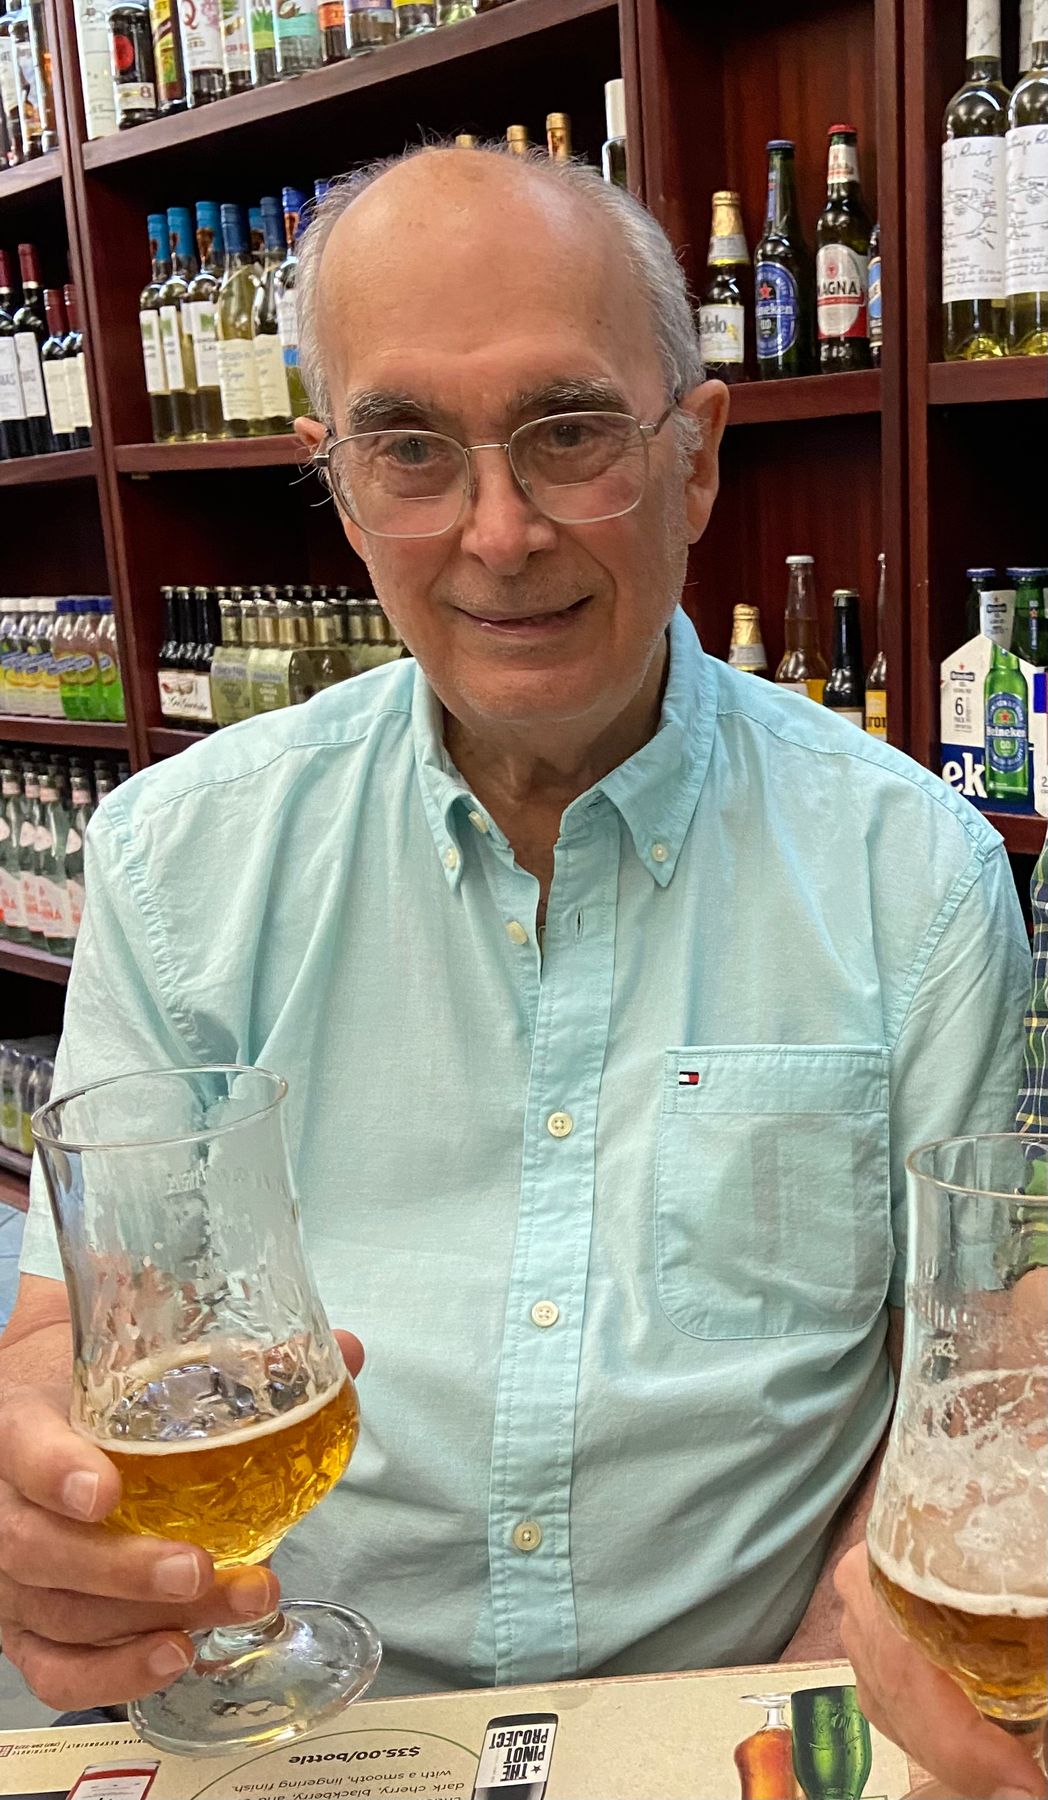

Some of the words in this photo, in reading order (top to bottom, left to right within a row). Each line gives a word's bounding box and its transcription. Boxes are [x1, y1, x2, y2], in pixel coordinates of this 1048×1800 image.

[955, 697, 964, 716] 6
[986, 727, 1027, 738] Heineken
[489, 1728, 549, 1749] PROJECT
[288, 1746, 422, 1765] $35.00/bottle
[503, 1745, 546, 1764] PINOT
[420, 1769, 452, 1780] with
[500, 1763, 528, 1781] THE
[278, 1777, 343, 1790] lingering
[348, 1774, 403, 1784] smooth,
[231, 1783, 275, 1794] finish.
[378, 1784, 426, 1796] cherry,
[434, 1782, 465, 1792] dark
